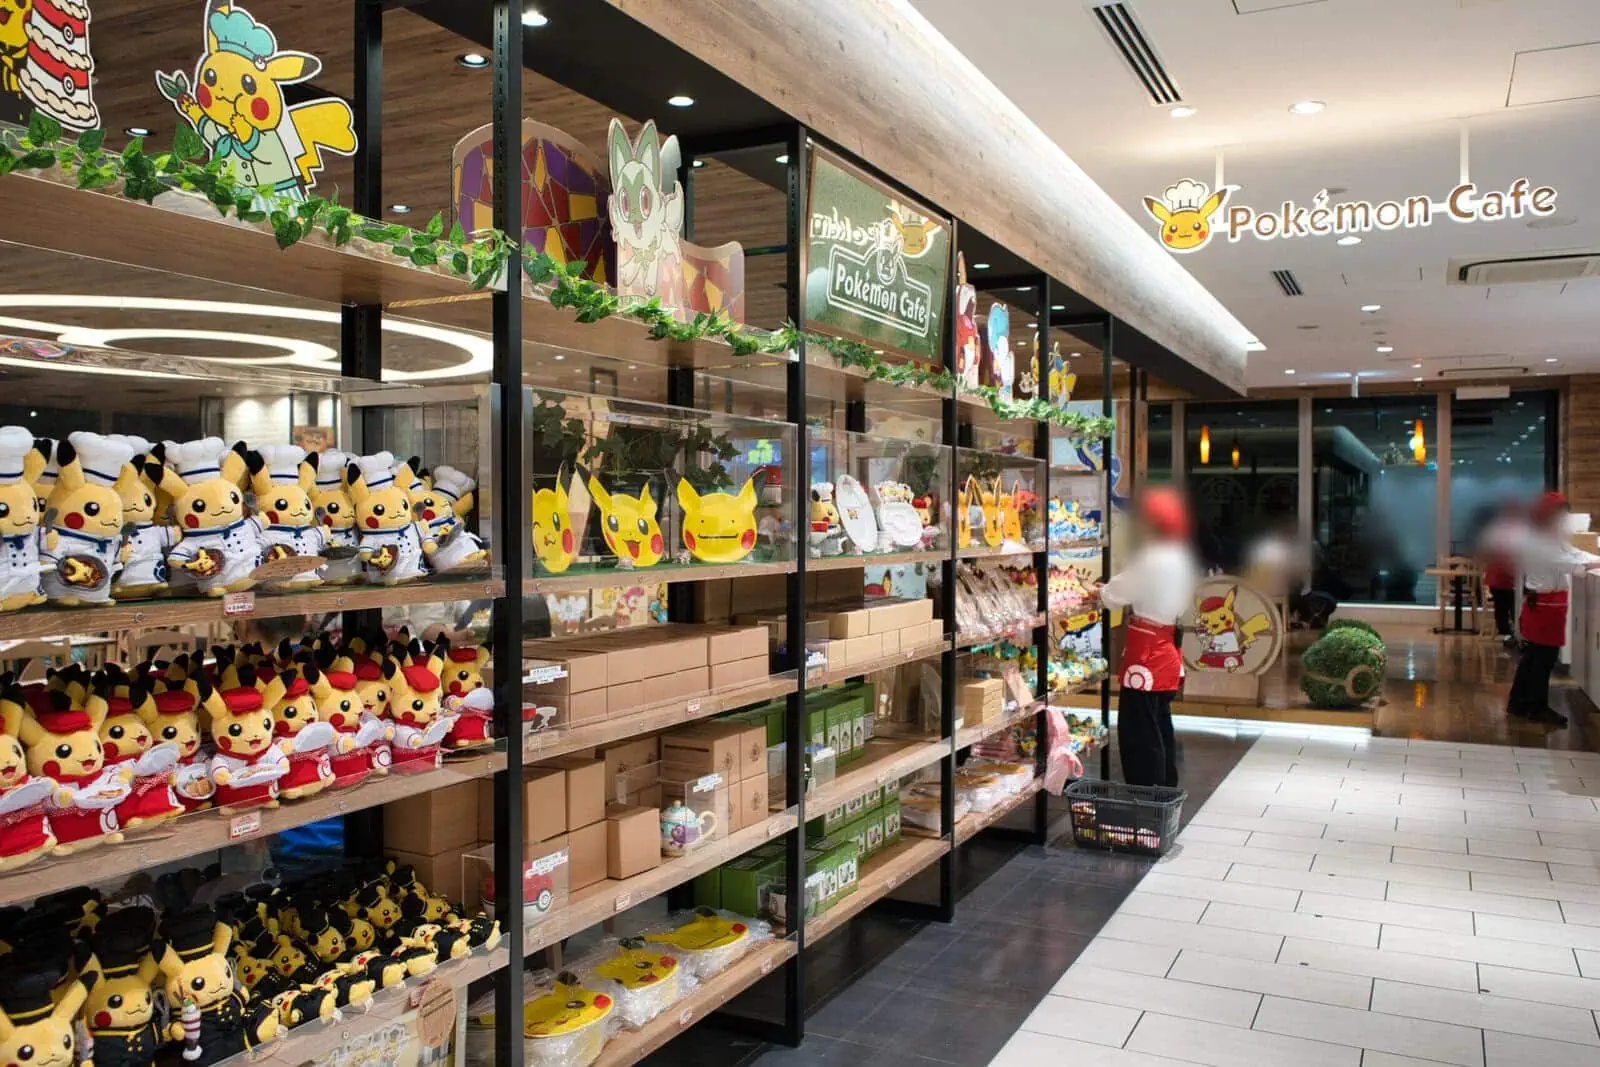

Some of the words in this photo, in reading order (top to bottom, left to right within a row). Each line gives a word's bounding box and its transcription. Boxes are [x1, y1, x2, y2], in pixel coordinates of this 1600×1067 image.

[1228, 189, 1430, 242] Pokémon
[1447, 178, 1558, 222] Cafe
[836, 263, 897, 313] Pokémon
[900, 293, 926, 323] Cafe
